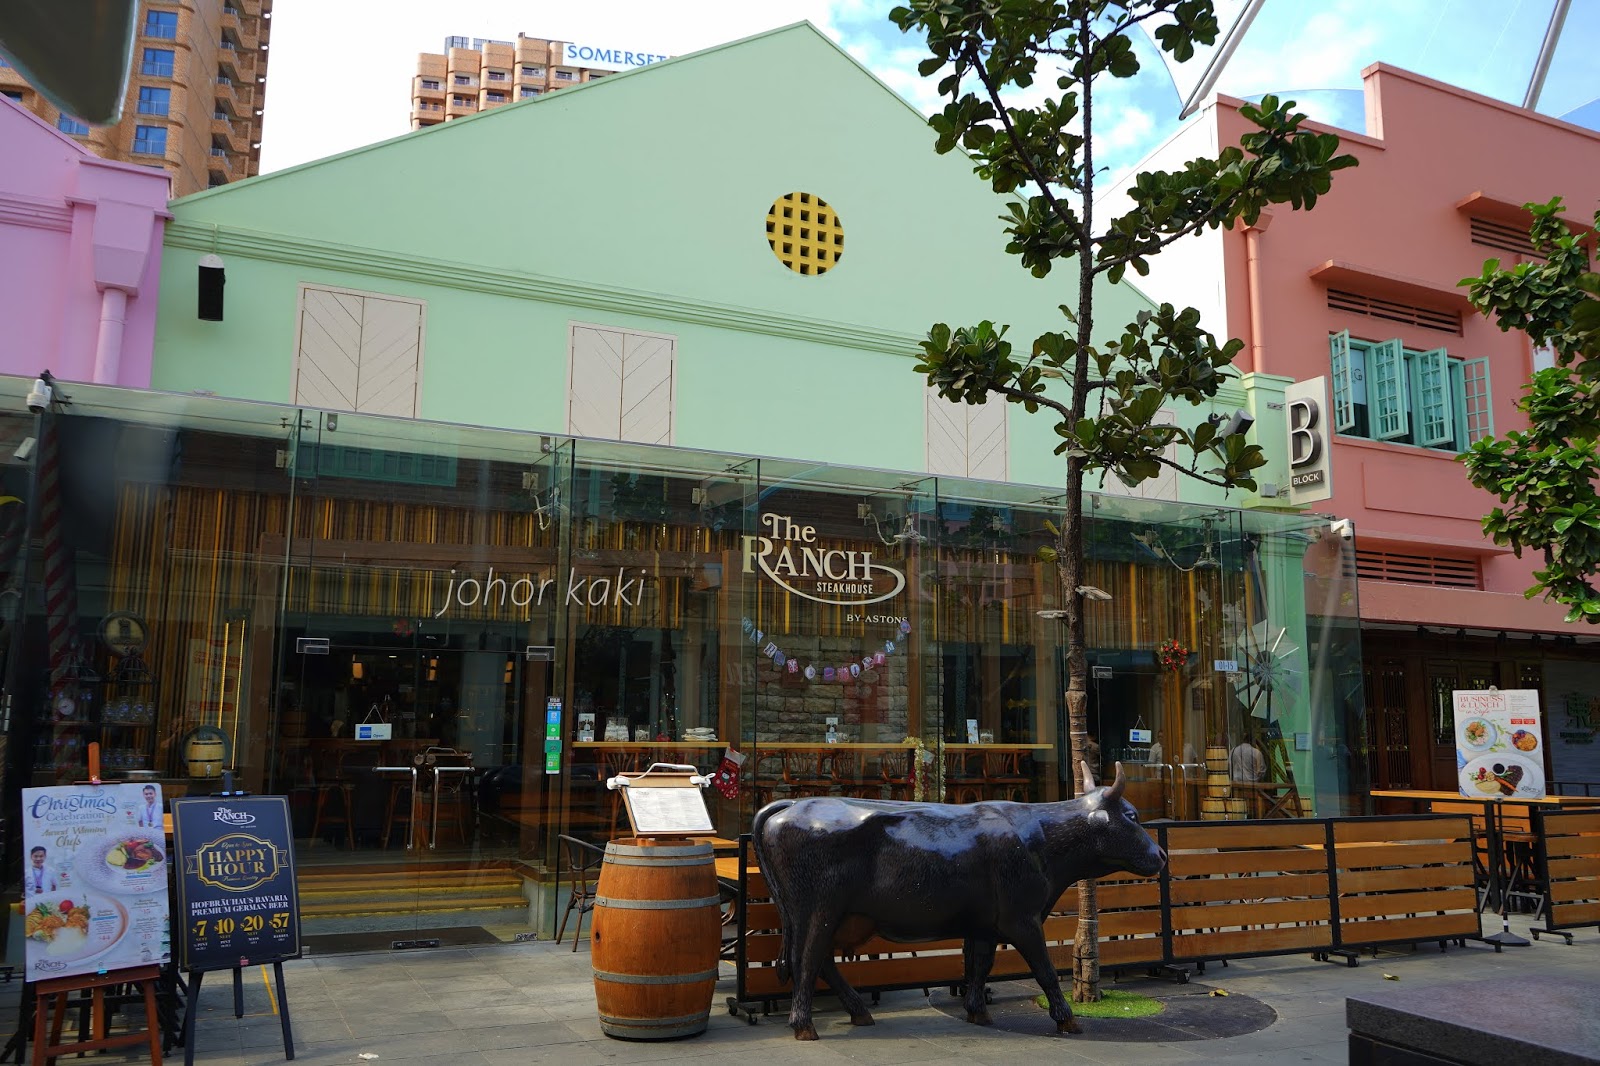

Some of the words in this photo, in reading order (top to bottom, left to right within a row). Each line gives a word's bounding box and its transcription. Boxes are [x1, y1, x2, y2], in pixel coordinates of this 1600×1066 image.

[1288, 397, 1322, 470] B
[1293, 473, 1320, 486] BLOCK
[762, 512, 817, 543] The
[741, 535, 875, 582] RANCH
[435, 566, 554, 619] johor
[565, 566, 646, 607] kaki
[816, 581, 874, 595] STEAKHOUSE
[846, 614, 861, 622] BY
[1469, 701, 1500, 709] LUNCH
[28, 790, 117, 819] Christmas
[45, 811, 105, 822] Celebration
[213, 811, 247, 821] RANCH
[55, 834, 82, 852] Chefs
[207, 848, 267, 864] HAPPY
[209, 861, 266, 877] HOUR
[255, 894, 289, 904] BAVARIA
[191, 906, 232, 917] PREMIUM
[232, 903, 267, 913] GERMAN
[268, 901, 289, 909] BEER
[192, 920, 208, 937] $7
[214, 917, 235, 934] $10
[240, 915, 264, 932] $20
[268, 912, 290, 929] $57
